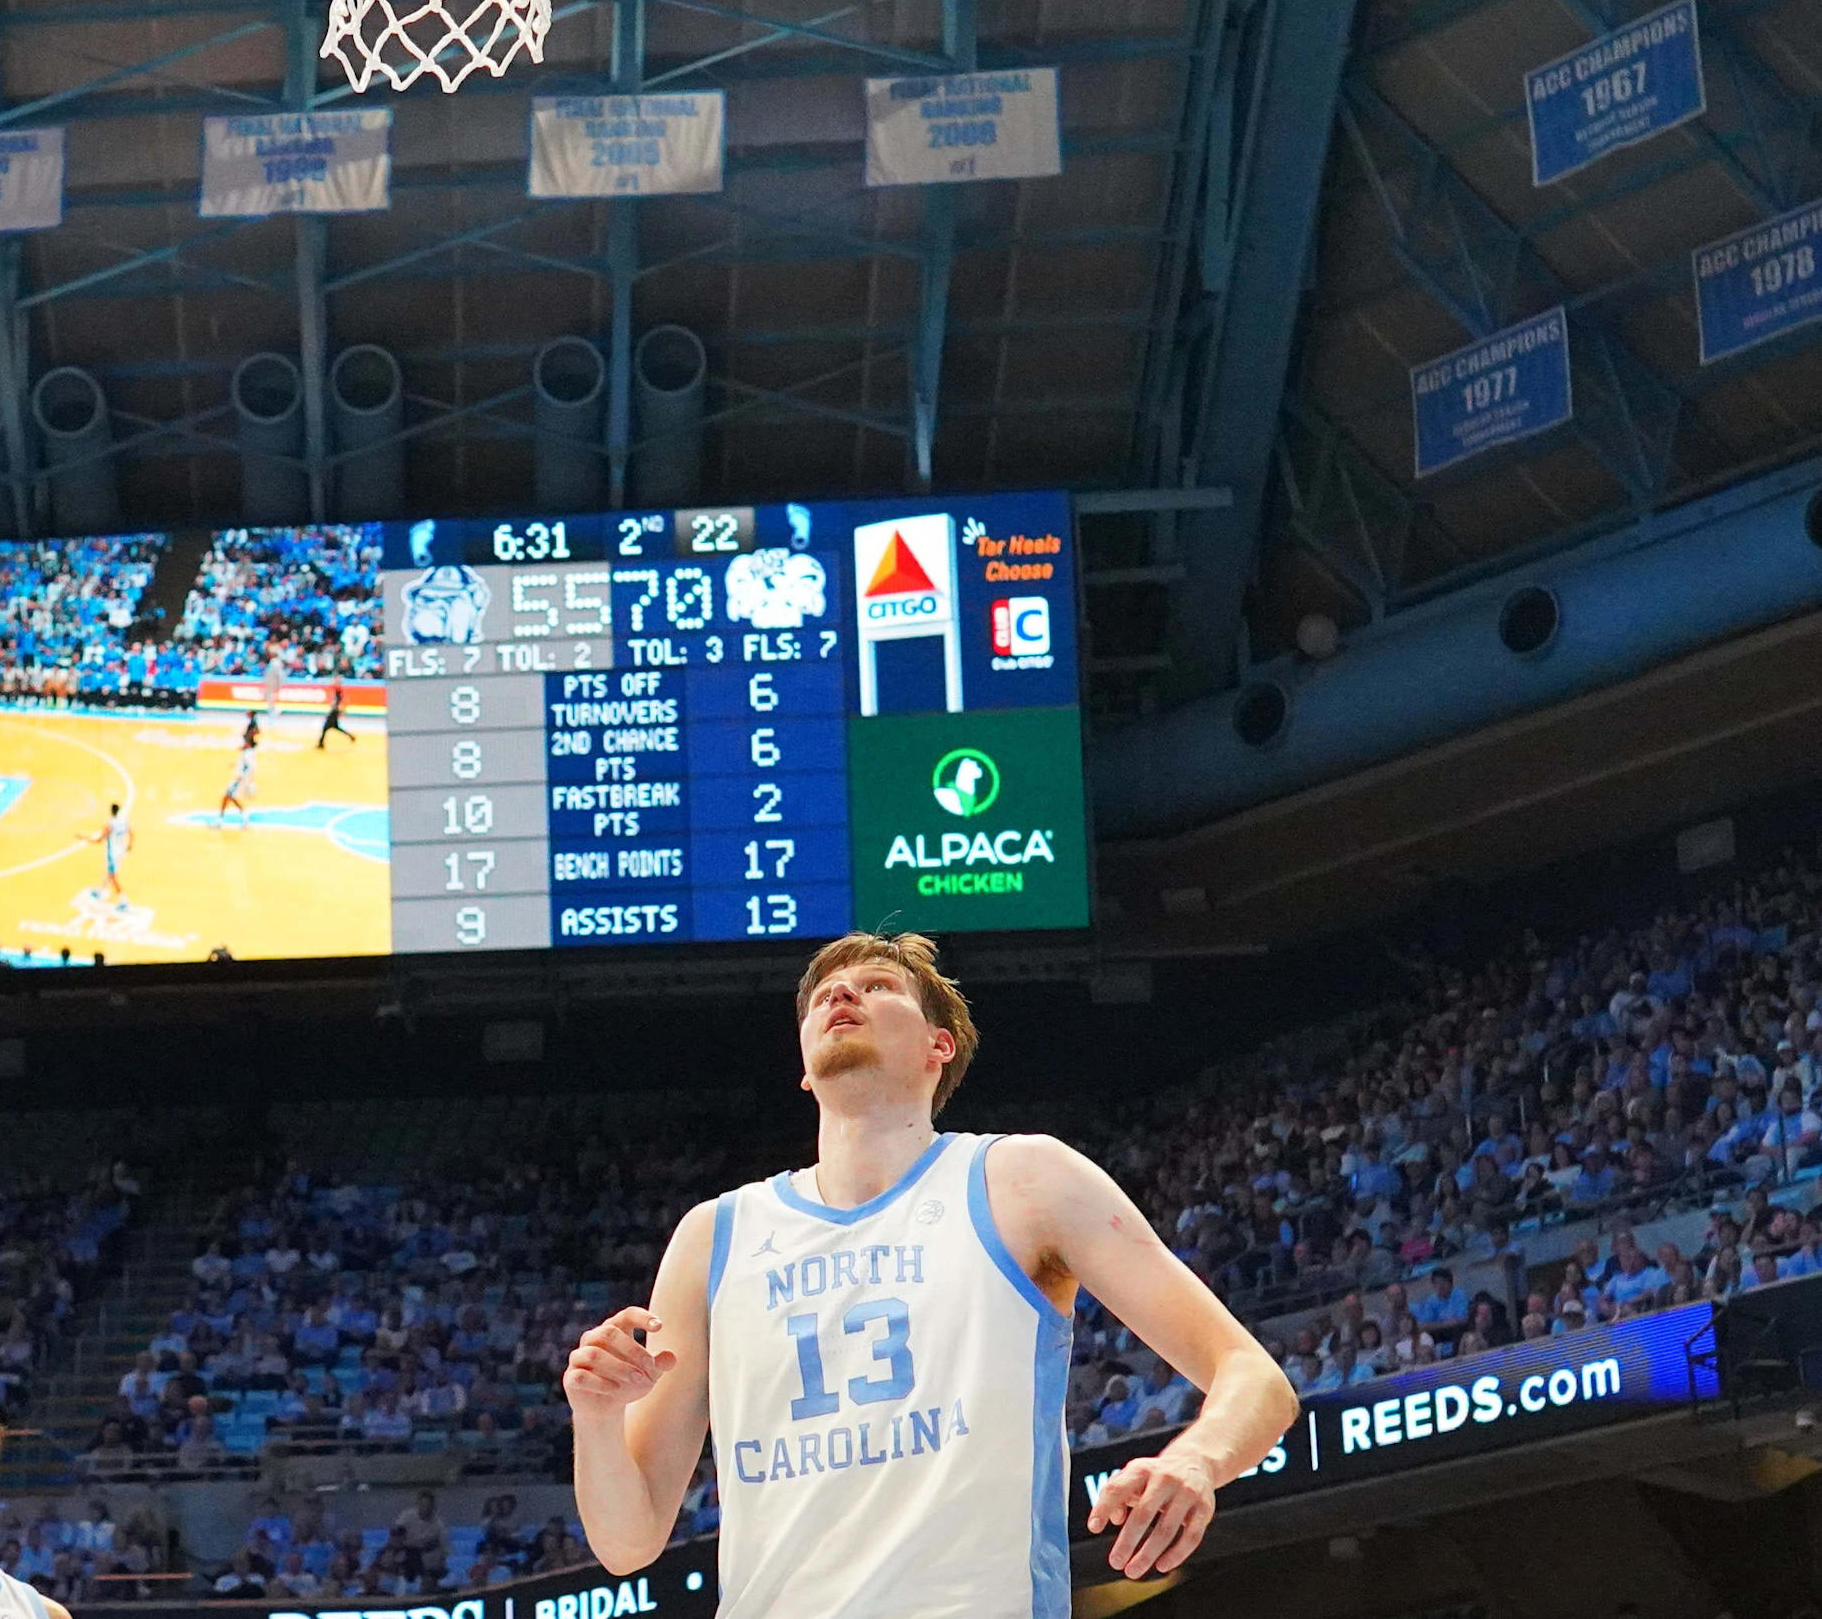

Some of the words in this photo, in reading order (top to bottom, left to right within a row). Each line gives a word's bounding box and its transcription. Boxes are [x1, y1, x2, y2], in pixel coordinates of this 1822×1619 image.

[1581, 61, 1647, 116] 1967
[1751, 245, 1815, 296] 1978
[1464, 365, 1517, 412] 1977
[493, 521, 570, 560] 6:31
[691, 514, 739, 552] 22
[512, 571, 611, 637] 55
[613, 567, 712, 632] 70
[868, 596, 936, 619] CITGO
[388, 648, 446, 677] FLS:
[463, 646, 481, 674] 7
[496, 643, 556, 672] TOL:
[574, 641, 592, 669] 2
[627, 637, 688, 666] TOL:
[705, 635, 724, 663] 3
[743, 632, 801, 661] FLS:
[819, 630, 837, 658] 7
[563, 674, 608, 698] PTS
[621, 672, 662, 696] OFF
[749, 673, 778, 711] 6
[451, 686, 480, 724] 8
[550, 699, 678, 727] TURNOVERS
[452, 740, 481, 779] 8
[551, 731, 592, 756] 2ND
[603, 727, 679, 754] CHANCE
[751, 728, 780, 767] 6
[595, 757, 636, 781] PTS
[443, 795, 493, 834] 10
[552, 783, 680, 810] FASTBREAK
[753, 783, 783, 823] 2
[593, 812, 640, 836] PTS
[554, 852, 609, 880] BENCH
[618, 849, 683, 878] POINTS
[744, 839, 795, 879] 17
[884, 830, 1054, 869] ALPACA
[444, 851, 495, 890] 17
[918, 872, 1023, 895] CHICKEN
[456, 906, 486, 945] 9
[561, 904, 678, 936] ASSISTS
[746, 894, 797, 934] 13
[766, 1245, 924, 1310] NORTH
[787, 1297, 915, 1421] 13
[1341, 1358, 1621, 1453] REEDS.com
[734, 1398, 969, 1484] CAROLINA
[535, 1577, 657, 1619] BRIDAL
